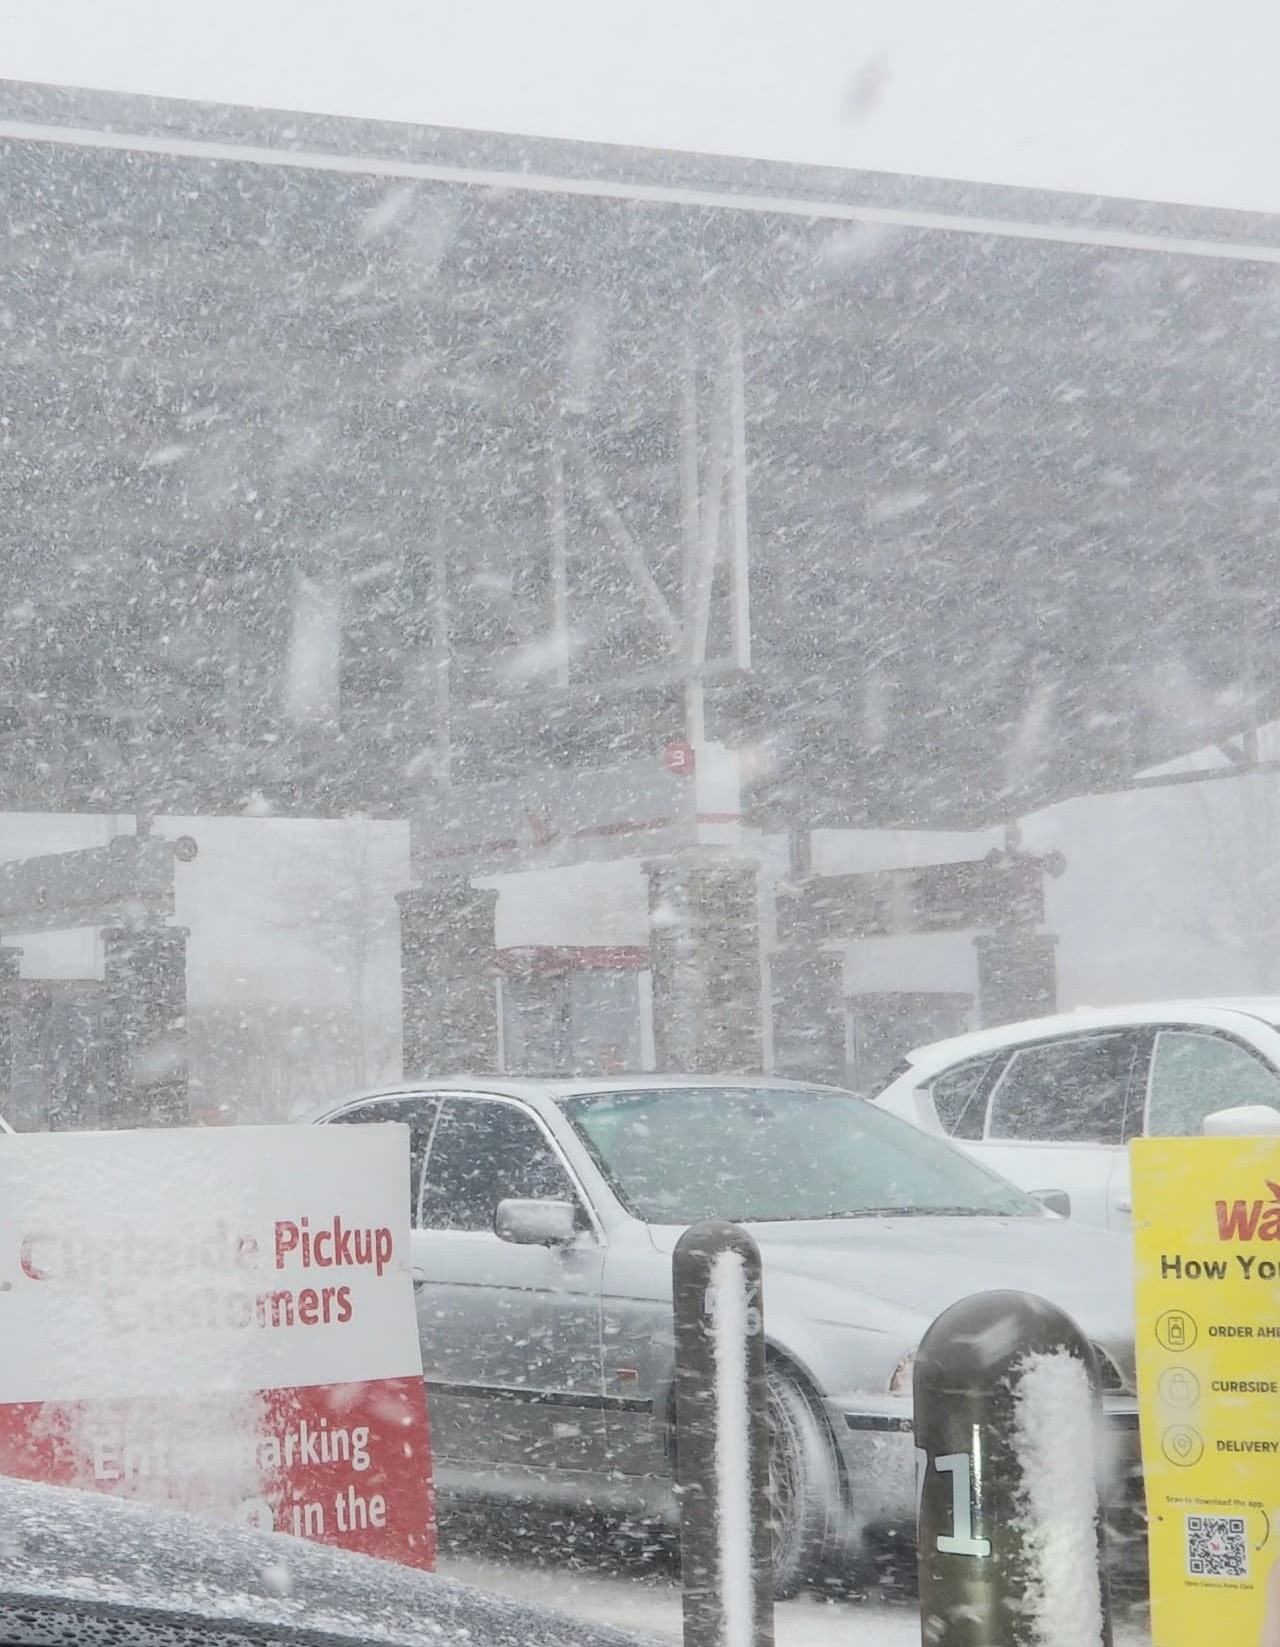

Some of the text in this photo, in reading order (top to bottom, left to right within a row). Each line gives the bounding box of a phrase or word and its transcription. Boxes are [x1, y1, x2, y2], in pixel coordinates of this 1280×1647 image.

[671, 749, 686, 767] 3
[274, 1215, 393, 1277] Pickup
[1160, 1254, 1280, 1280] How Yo
[1208, 1325, 1254, 1339] ORDER
[1211, 1380, 1279, 1394] CURBSIDE
[252, 1417, 371, 1472] arking
[1216, 1440, 1280, 1453] DELIVERY
[291, 1492, 324, 1537] in
[335, 1484, 387, 1532] the
